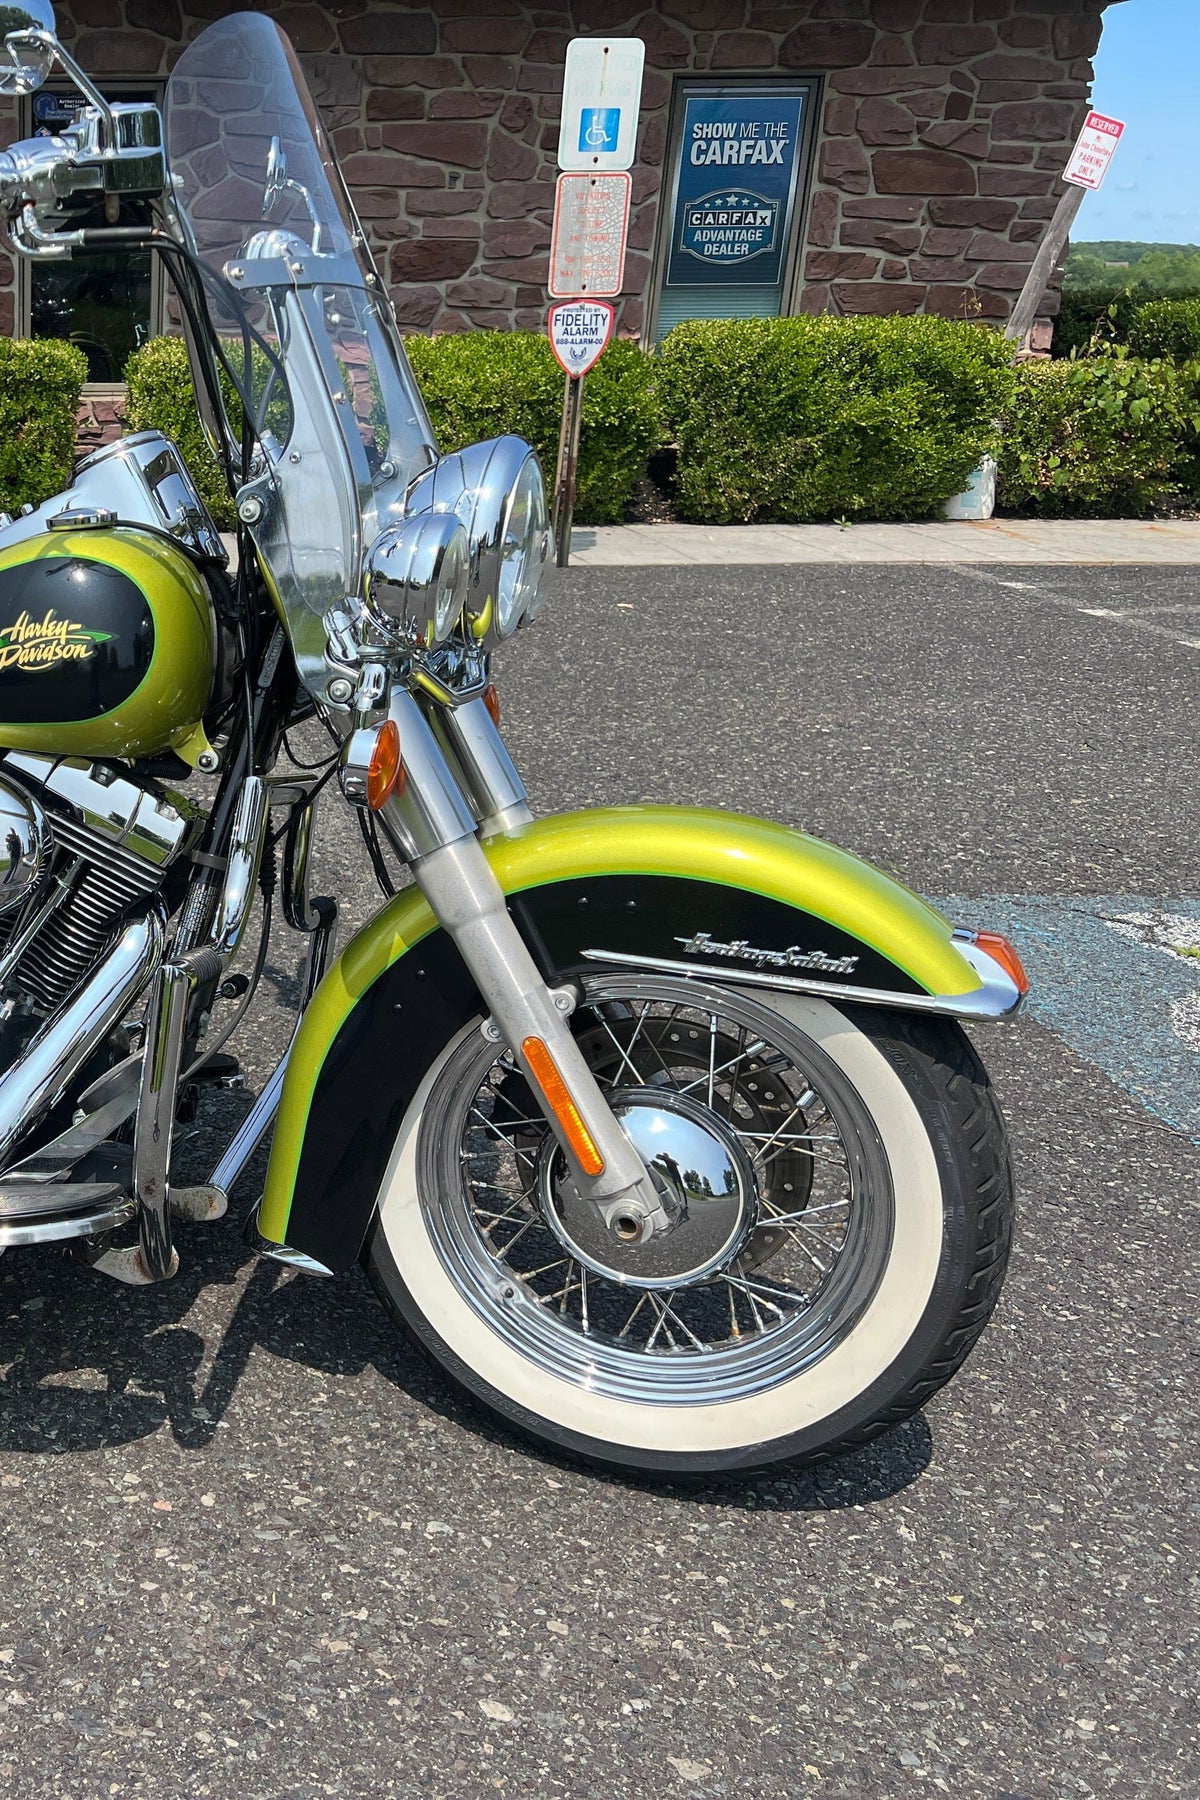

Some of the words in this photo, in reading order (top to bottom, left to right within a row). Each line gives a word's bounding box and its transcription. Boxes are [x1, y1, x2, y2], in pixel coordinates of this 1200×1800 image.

[692, 122, 737, 138] SHOW
[739, 122, 760, 138] ME
[763, 122, 788, 138] THE
[1089, 117, 1120, 135] RESERVED
[690, 140, 785, 165] CARFAX
[1078, 152, 1103, 168] PARKING
[1078, 165, 1094, 176] ONLY
[691, 213, 769, 226] CARFAX
[693, 229, 763, 242] ADVANTAGE
[704, 243, 749, 256] DEALER
[554, 314, 608, 326] FIDELITY
[562, 327, 598, 336] ALARM
